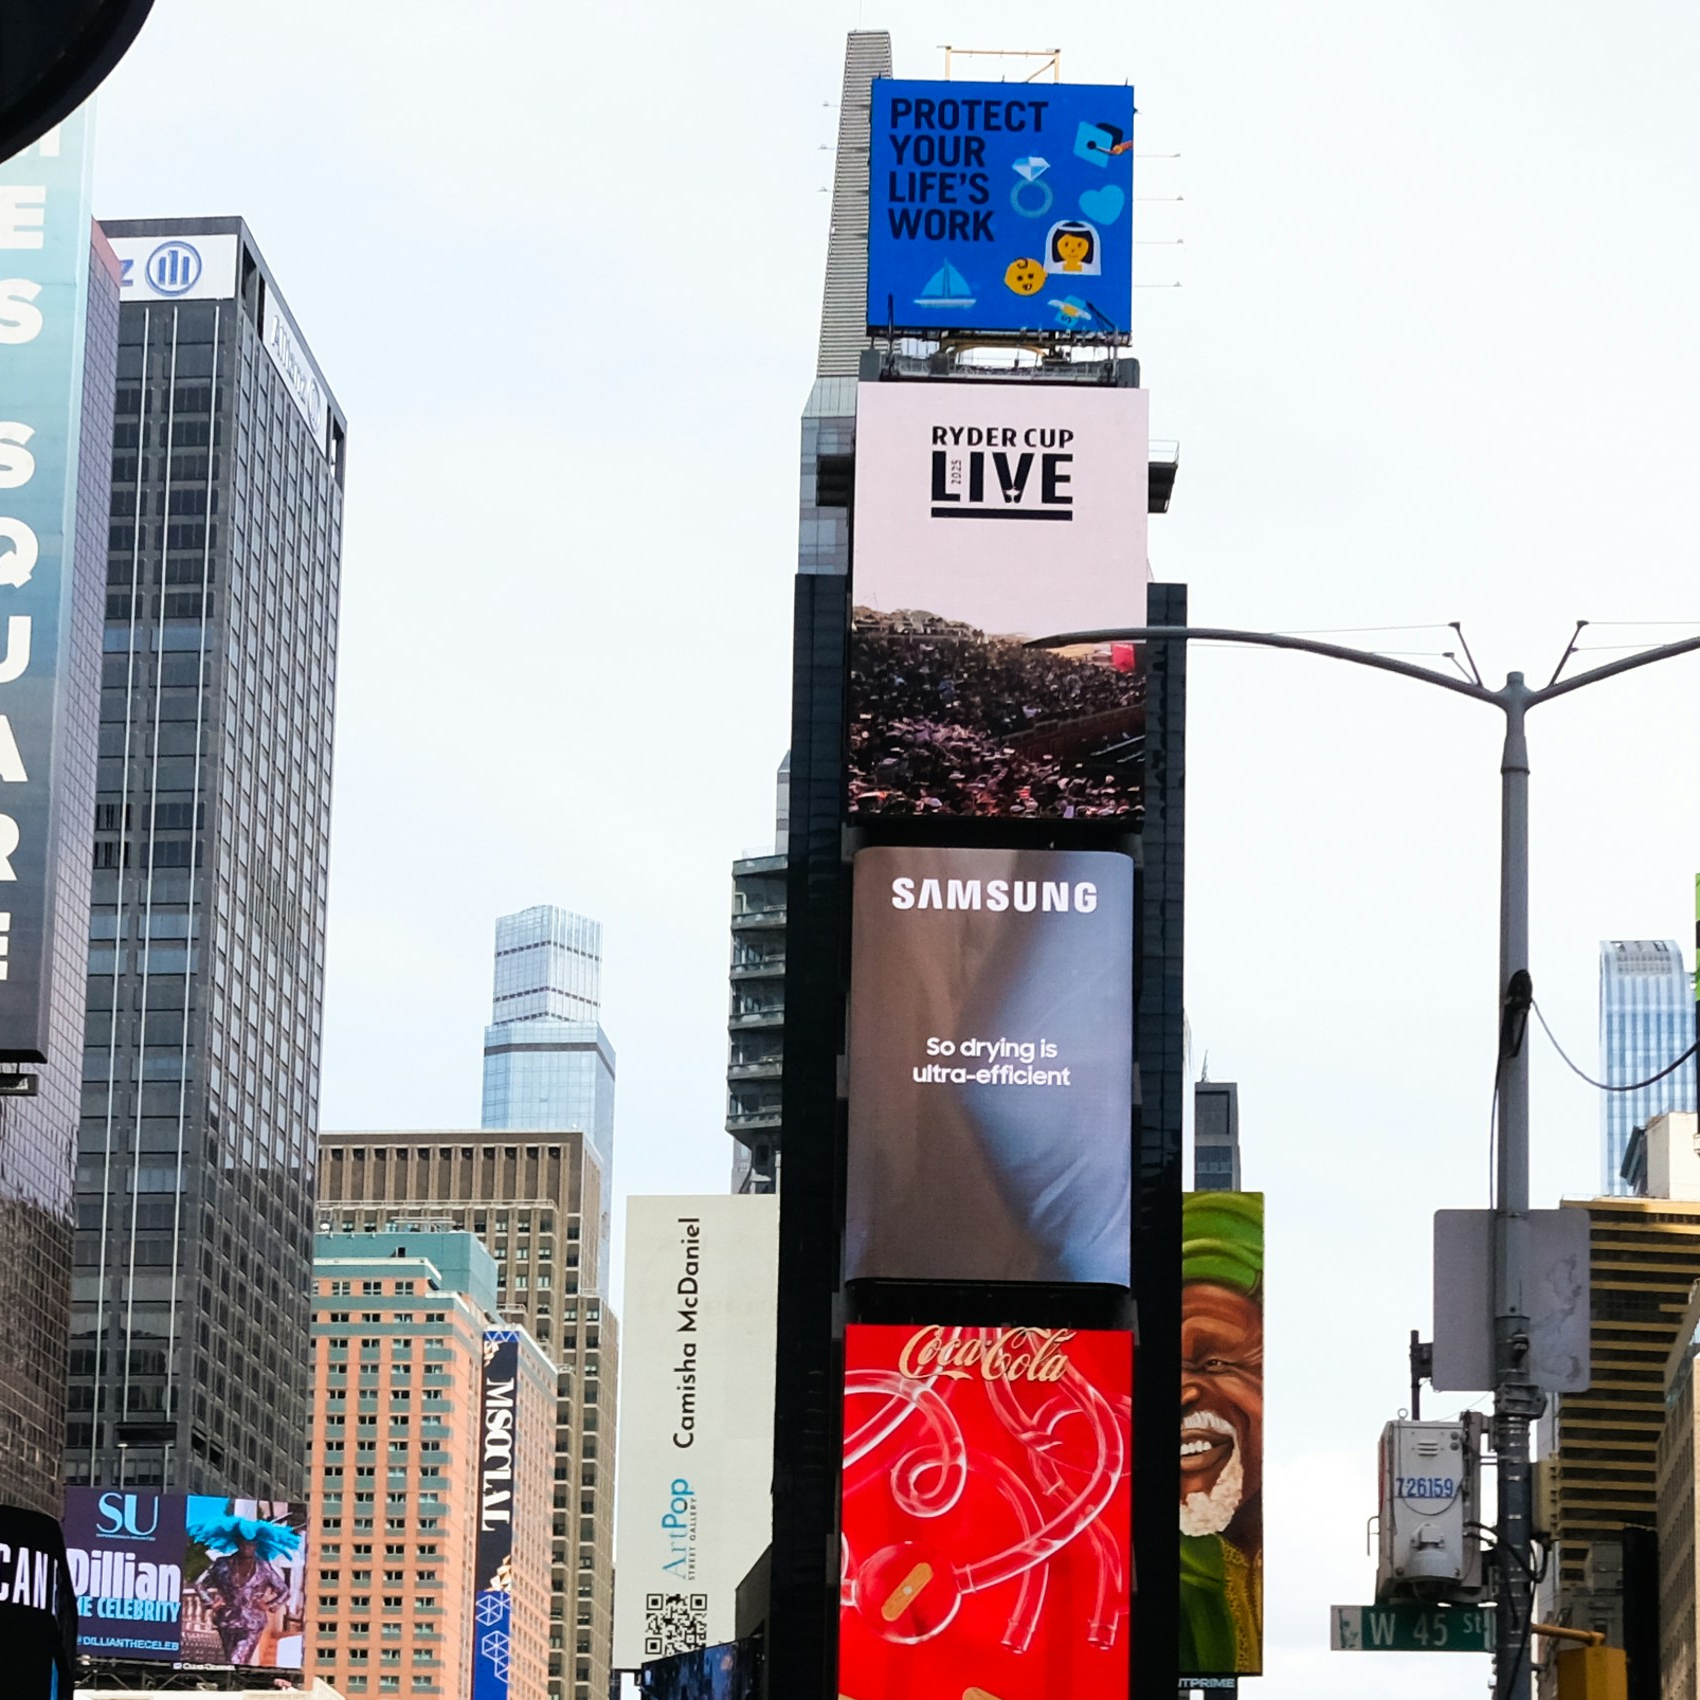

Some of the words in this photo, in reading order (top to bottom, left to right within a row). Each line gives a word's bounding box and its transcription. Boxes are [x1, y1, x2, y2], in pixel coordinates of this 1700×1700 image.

[890, 98, 1049, 132] PROTECT
[889, 134, 985, 167] YOUR
[889, 171, 990, 204] LIFE'S
[888, 207, 995, 242] WORK
[270, 314, 306, 399] Allianz
[931, 426, 1017, 447] RYDER
[1024, 428, 1074, 448] CUP
[931, 450, 1074, 504] LIVE
[891, 877, 1098, 914] SAMSUNG
[926, 1036, 956, 1056] So
[960, 1037, 1035, 1063] drying
[1040, 1039, 1059, 1059] is
[912, 1062, 1071, 1087] ultra-efficient
[676, 1217, 701, 1333] McDaniel
[898, 1323, 1078, 1383] Coca-Cola
[672, 1341, 698, 1450] Camisha
[1394, 1476, 1454, 1499] 726159
[95, 1491, 160, 1537] SU
[661, 1477, 696, 1580] ArtPop
[66, 1547, 182, 1603] Dillian
[97, 1597, 182, 1624] CELEBRITY
[1370, 1613, 1398, 1647] W
[1412, 1613, 1449, 1647] 45
